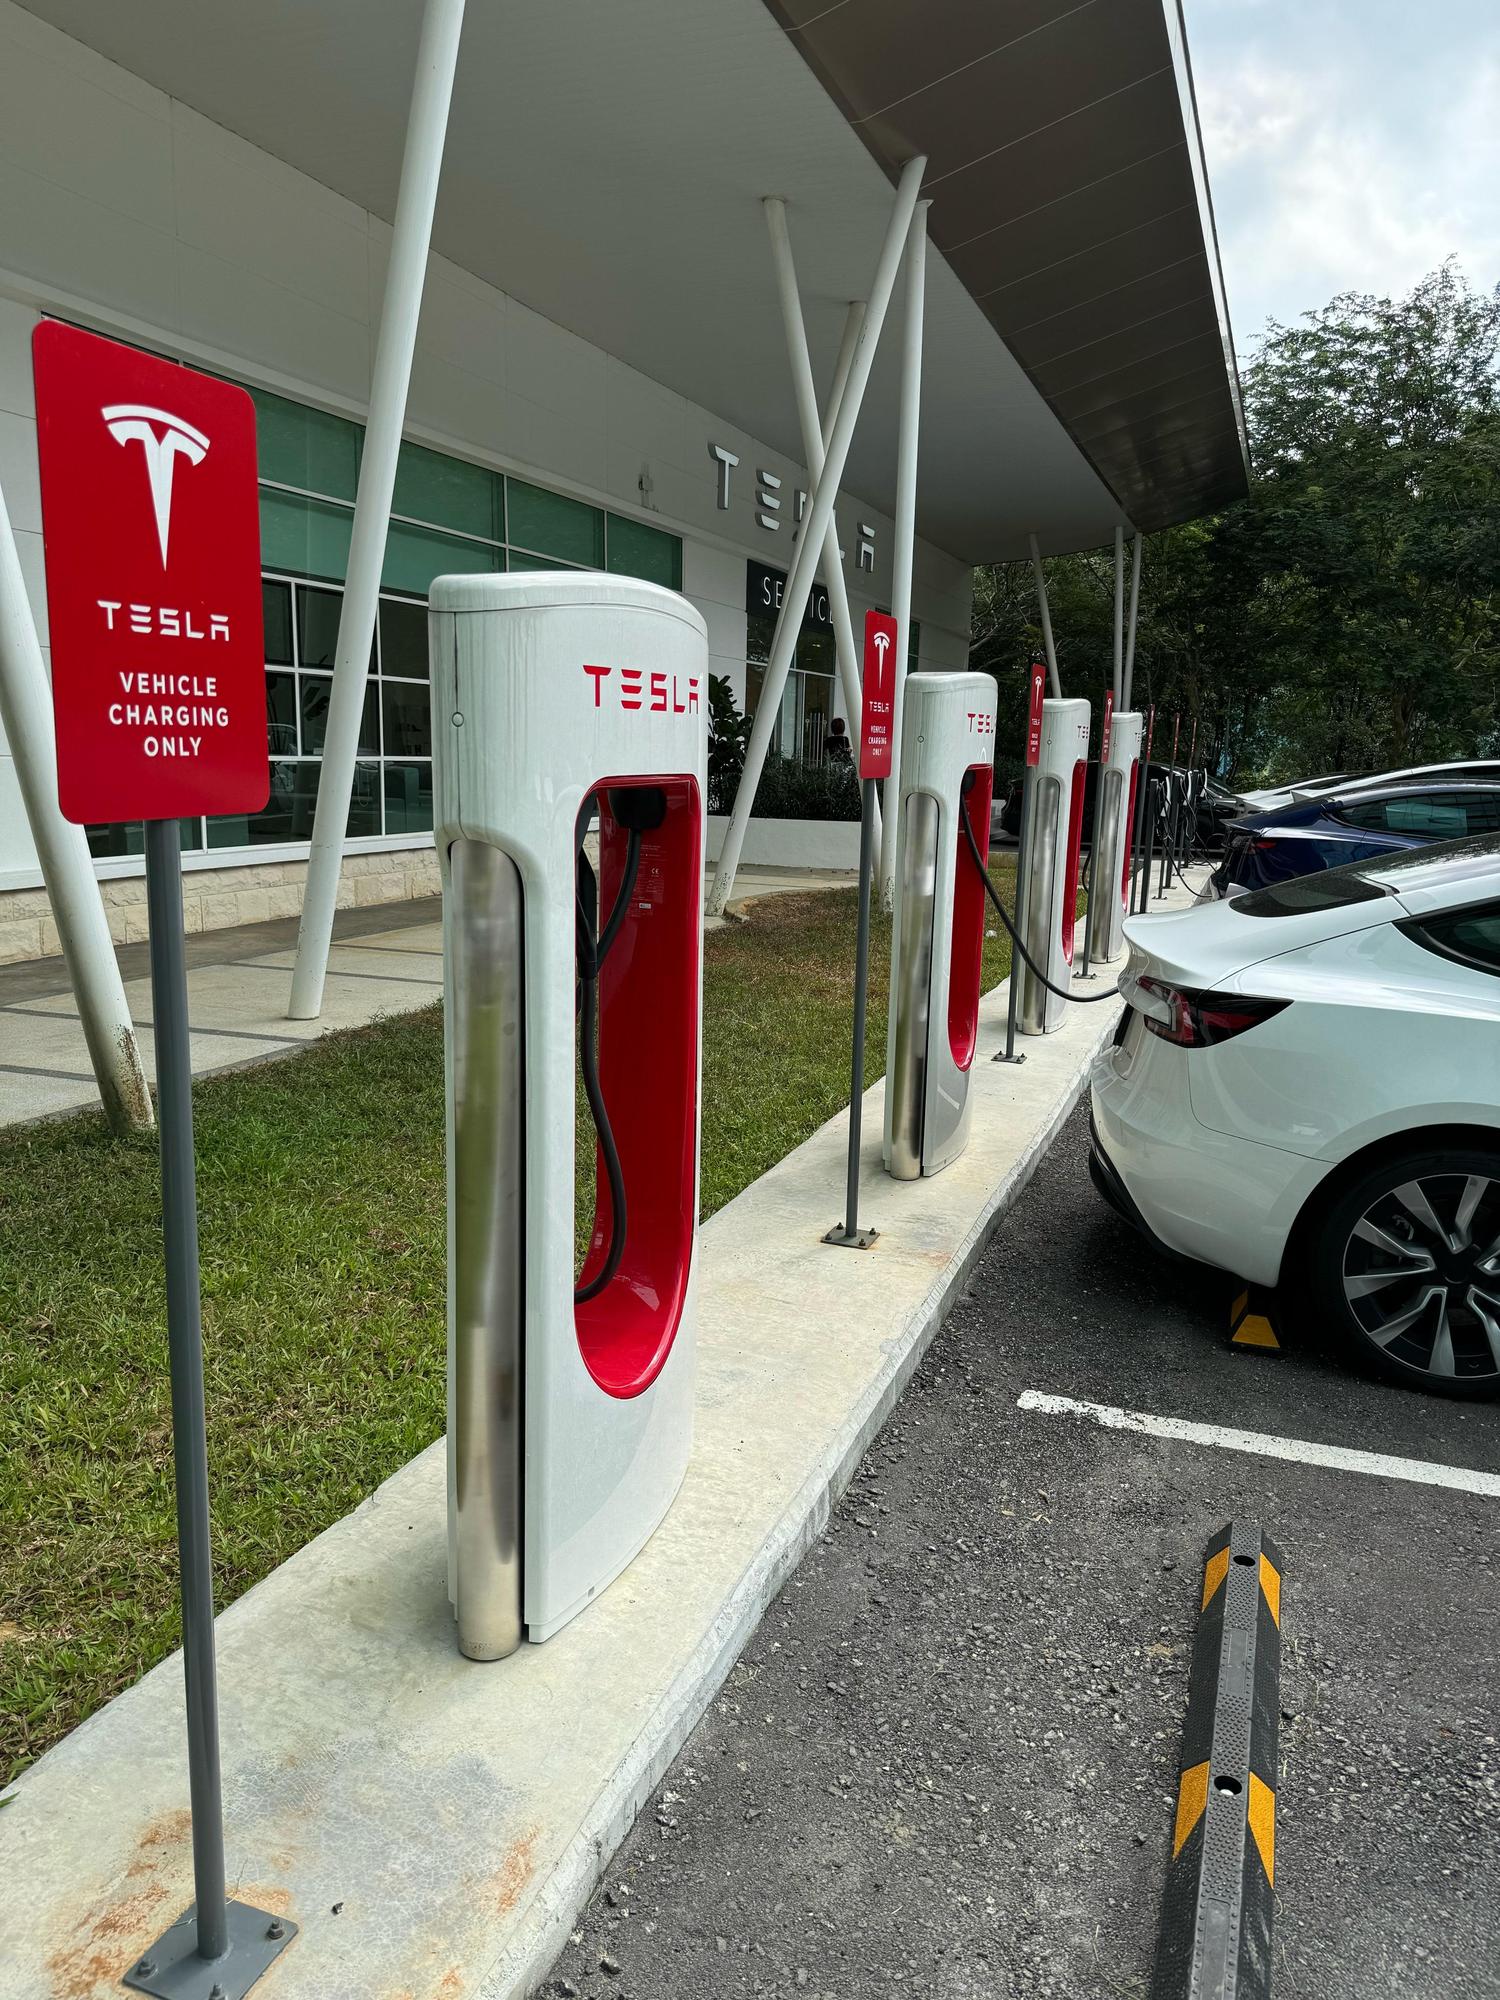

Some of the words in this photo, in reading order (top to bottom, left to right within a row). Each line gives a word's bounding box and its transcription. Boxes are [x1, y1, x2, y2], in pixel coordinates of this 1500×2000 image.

[713, 444, 875, 573] TEA
[97, 600, 230, 641] TESLA
[119, 671, 217, 697] VEHICLE
[583, 665, 699, 714] TESLA
[109, 704, 229, 727] CHARGING
[869, 701, 889, 712] TESLA
[144, 736, 202, 757] ONLY
[868, 737, 887, 745] CHARGING
